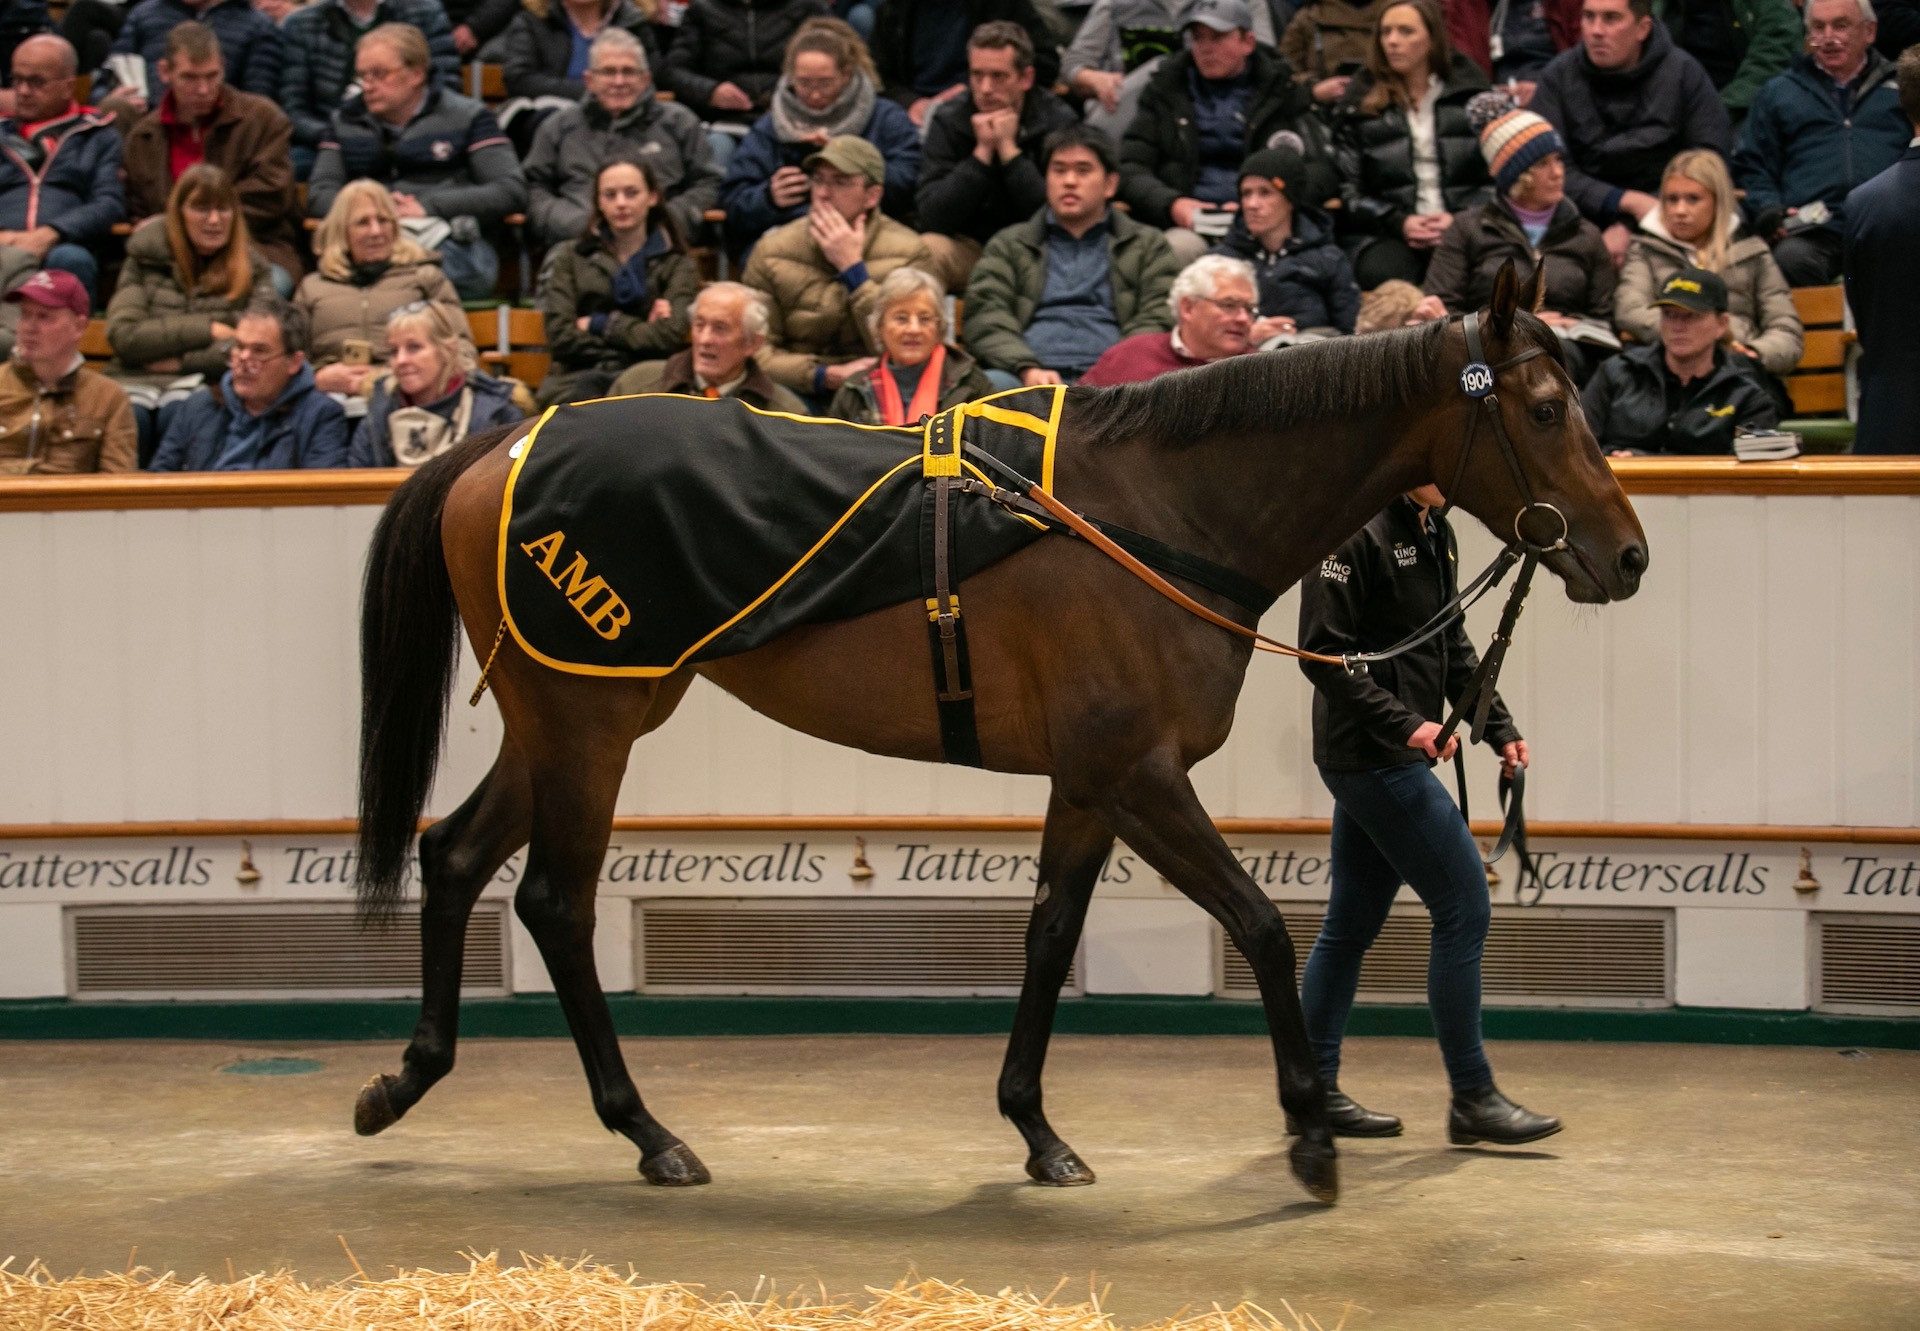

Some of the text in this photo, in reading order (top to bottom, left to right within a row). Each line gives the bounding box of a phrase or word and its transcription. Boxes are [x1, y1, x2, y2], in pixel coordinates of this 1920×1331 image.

[1461, 369, 1493, 392] 1904
[1393, 546, 1417, 559] KING
[1319, 569, 1349, 584] POWER
[1321, 559, 1352, 576] KING
[520, 530, 632, 641] AMB
[1524, 851, 1770, 895] Tattersalls
